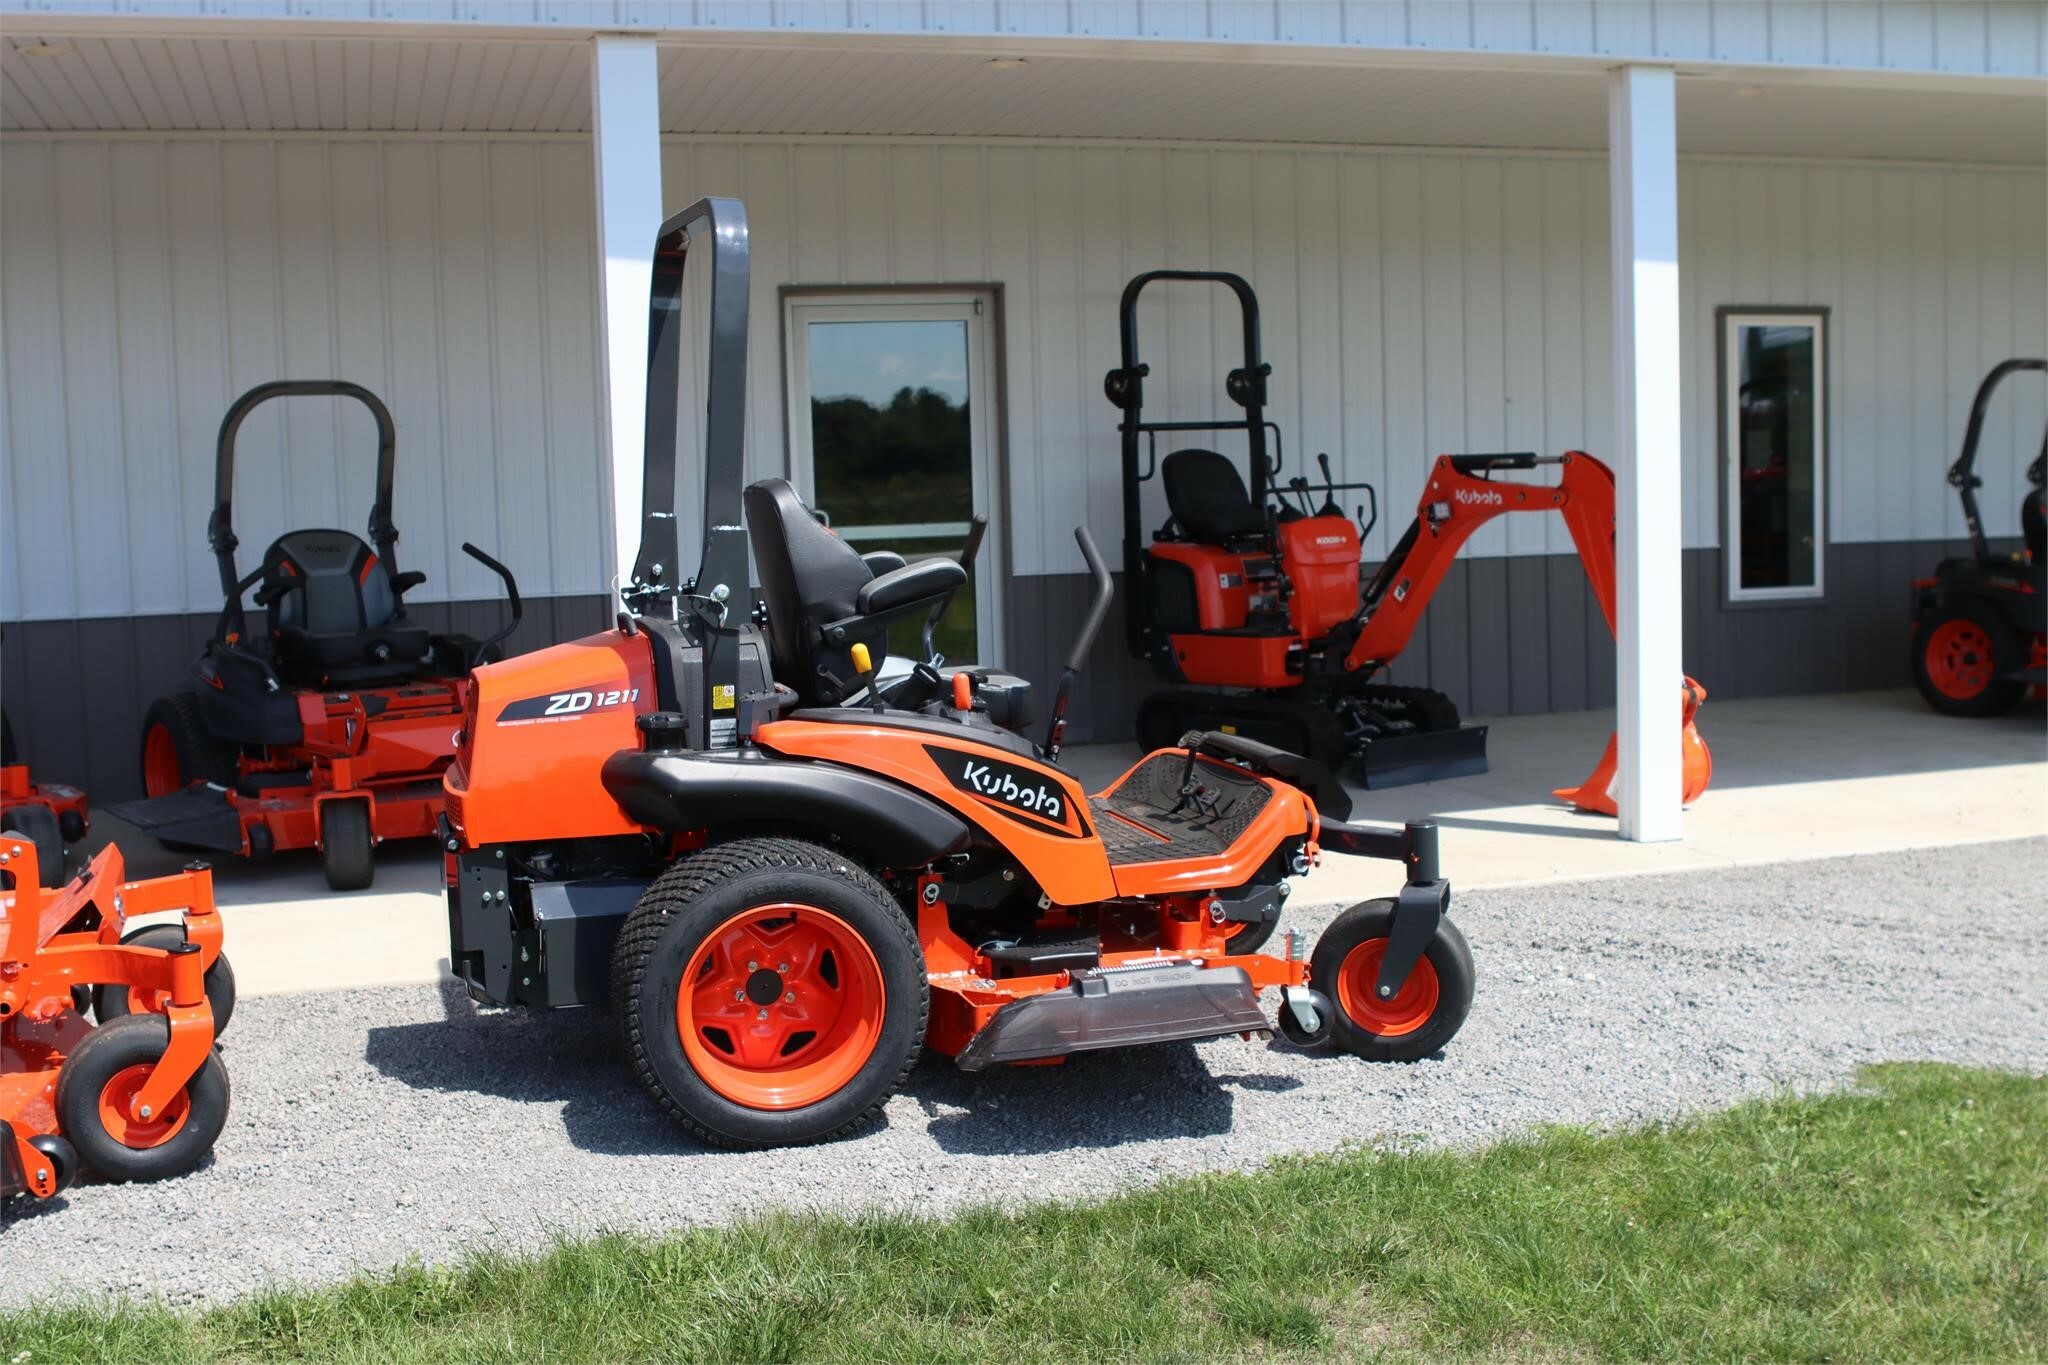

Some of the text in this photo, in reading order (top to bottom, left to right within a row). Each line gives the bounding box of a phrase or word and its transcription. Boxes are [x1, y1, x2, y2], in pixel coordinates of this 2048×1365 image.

[1455, 488, 1503, 505] Kubota
[544, 688, 640, 715] ZD 1211
[963, 760, 1060, 817] Kubota
[1114, 971, 1193, 988] DO NOT REMOVE
